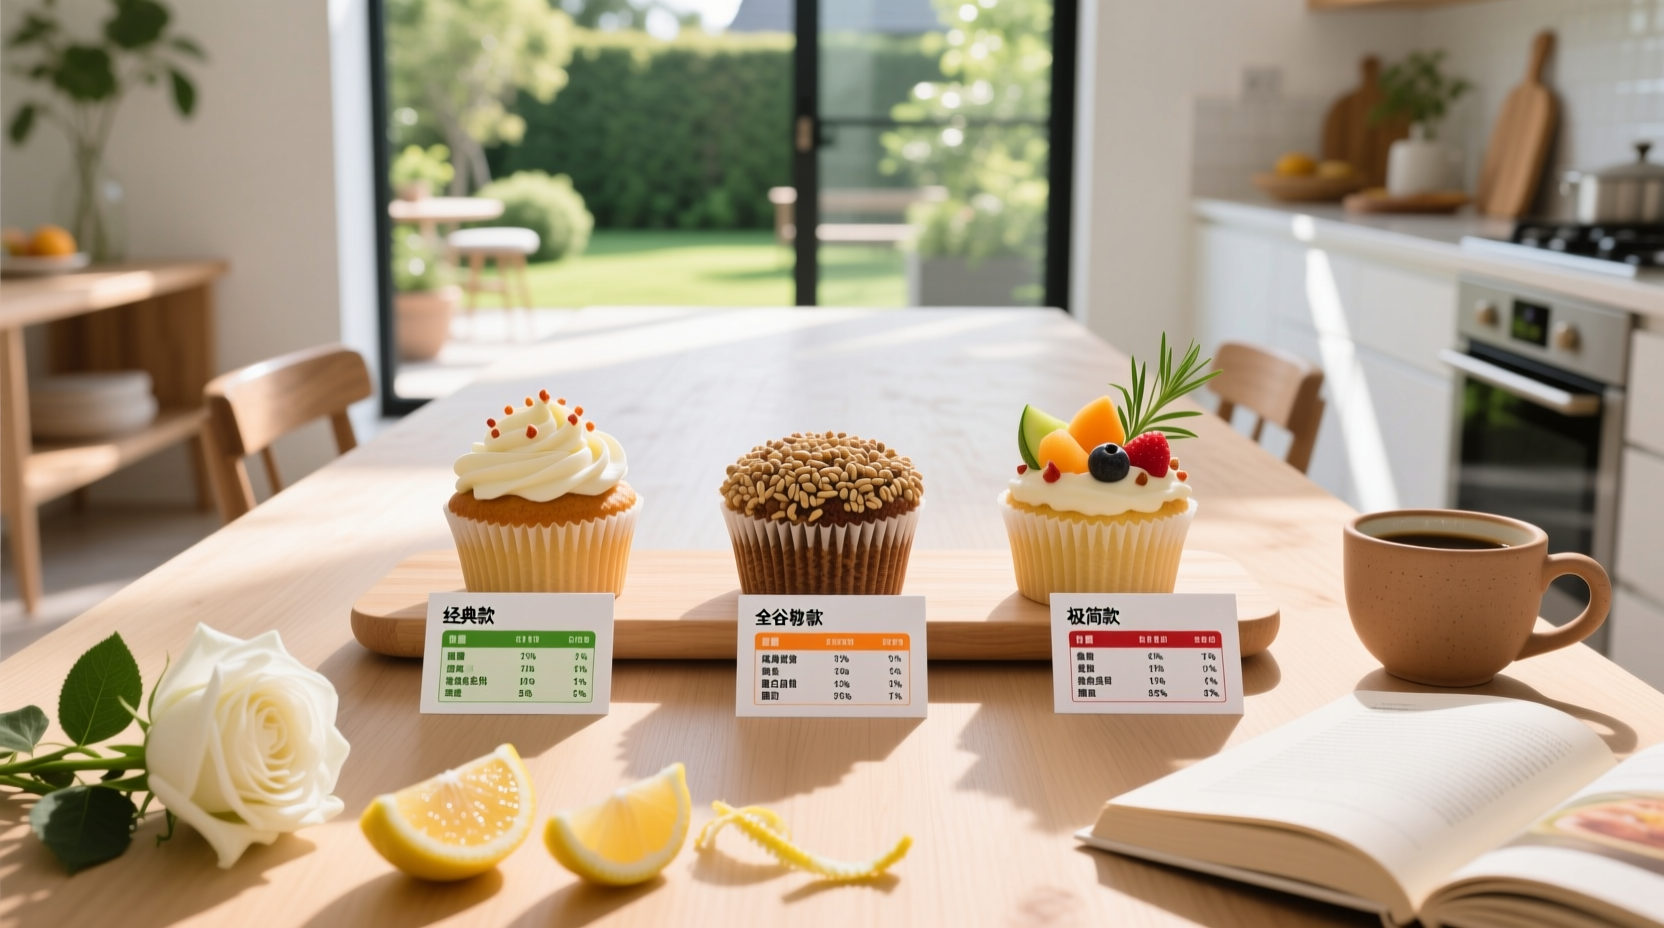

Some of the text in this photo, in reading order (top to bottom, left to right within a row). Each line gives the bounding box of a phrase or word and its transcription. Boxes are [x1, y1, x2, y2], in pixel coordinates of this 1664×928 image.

[442, 606, 495, 625] 经典款
[1067, 606, 1120, 625] 极简款
